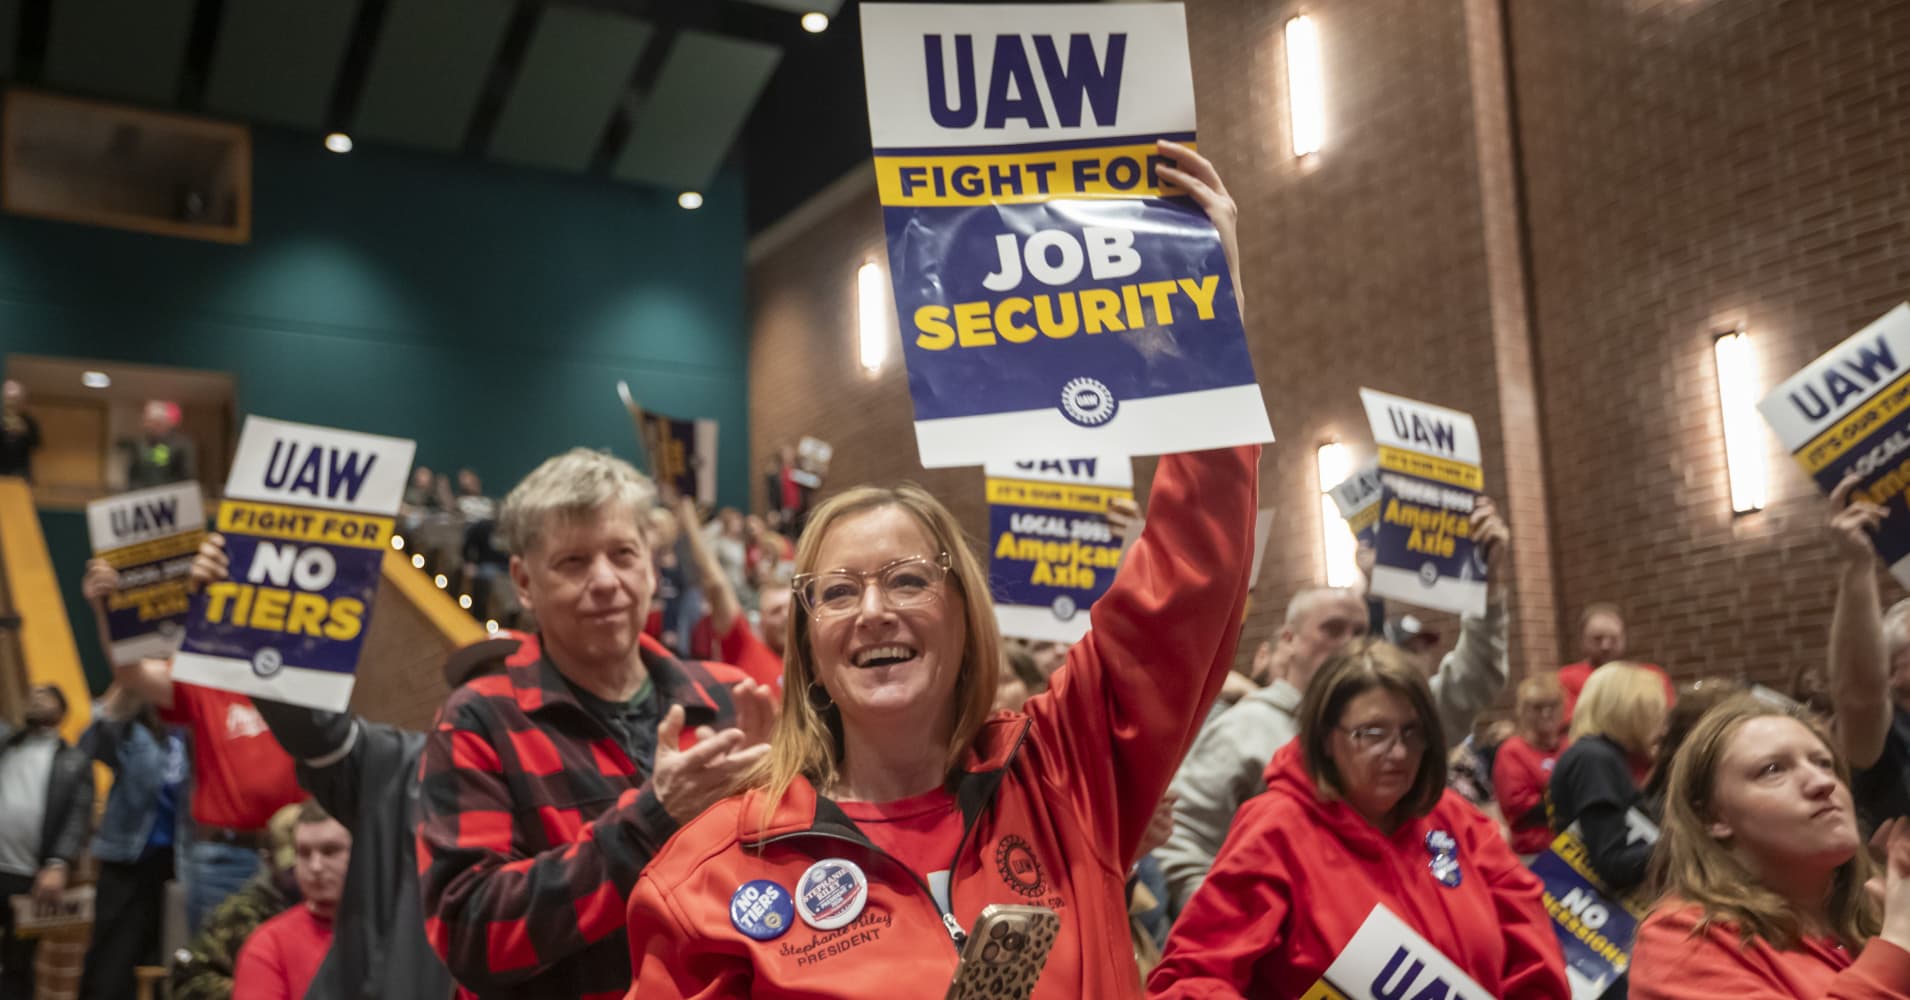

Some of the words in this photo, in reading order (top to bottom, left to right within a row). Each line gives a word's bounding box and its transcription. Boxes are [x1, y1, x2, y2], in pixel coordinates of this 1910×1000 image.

[923, 33, 1127, 129] UAW
[900, 162, 1056, 197] FIGHT
[982, 227, 1142, 291] JOB
[914, 275, 1220, 351] SECURITY
[1791, 335, 1898, 421] UAW
[1387, 405, 1455, 452] UAW
[262, 439, 378, 501] UAW
[110, 496, 178, 538] UAW
[229, 507, 311, 534] FIGHT
[321, 518, 381, 542] FOR
[1011, 512, 1068, 538] LOCAL
[996, 532, 1121, 568] American
[1407, 524, 1456, 558] Axle
[247, 542, 337, 591] NO
[1030, 558, 1095, 590] Axle
[204, 582, 367, 641] TIERS
[737, 886, 760, 911] NO
[741, 885, 779, 929] TIERS
[1560, 887, 1609, 930] NO
[797, 928, 881, 967] PRESIDENT
